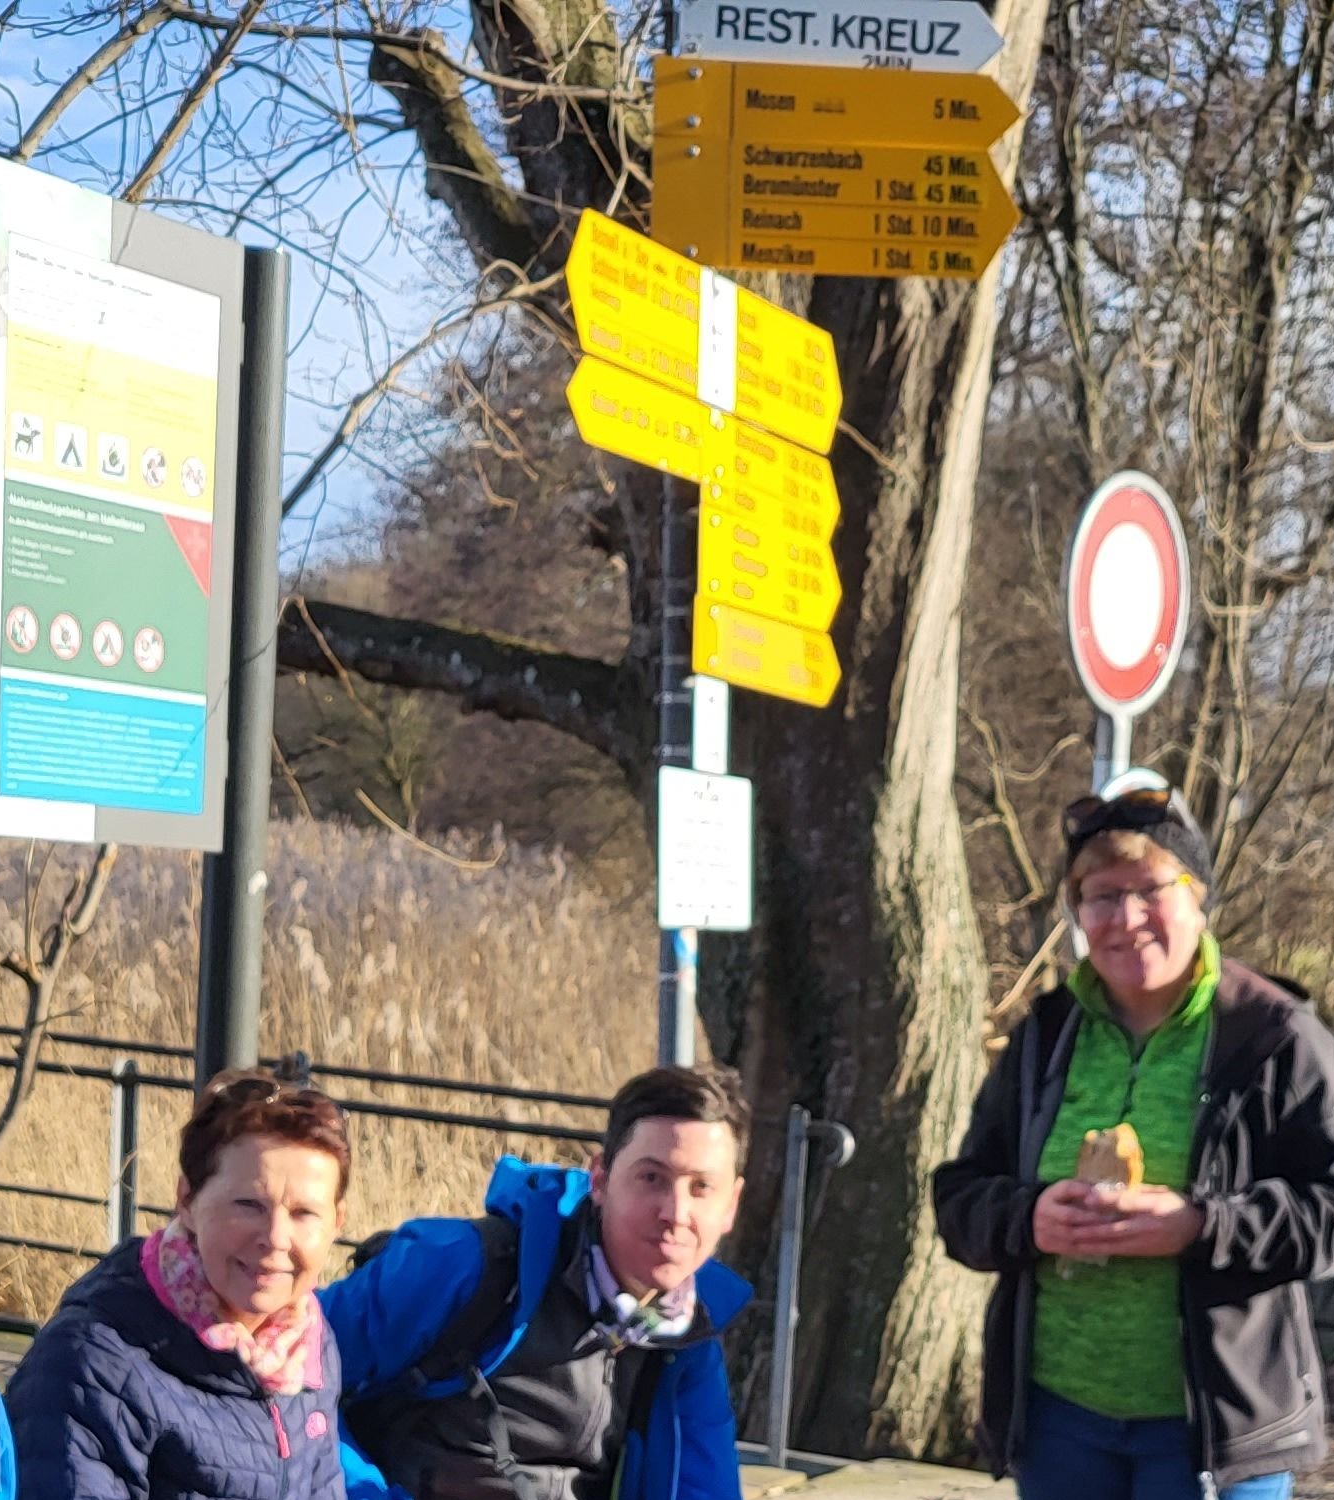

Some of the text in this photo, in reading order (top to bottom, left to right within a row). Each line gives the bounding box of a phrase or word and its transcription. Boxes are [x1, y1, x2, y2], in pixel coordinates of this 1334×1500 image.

[716, 5, 962, 57] REST. KREUZ
[746, 88, 982, 121] Mosen 5 Min.
[744, 145, 980, 177] Schwarzenbach 45 Min.
[874, 179, 882, 199] 1
[888, 180, 916, 201] Std.
[924, 183, 944, 203] 45
[949, 184, 981, 205] Min.
[742, 207, 979, 238] Reinach 1 Std. 10 Min.
[741, 242, 976, 272] Menziken 1 Std. 5 Min.
